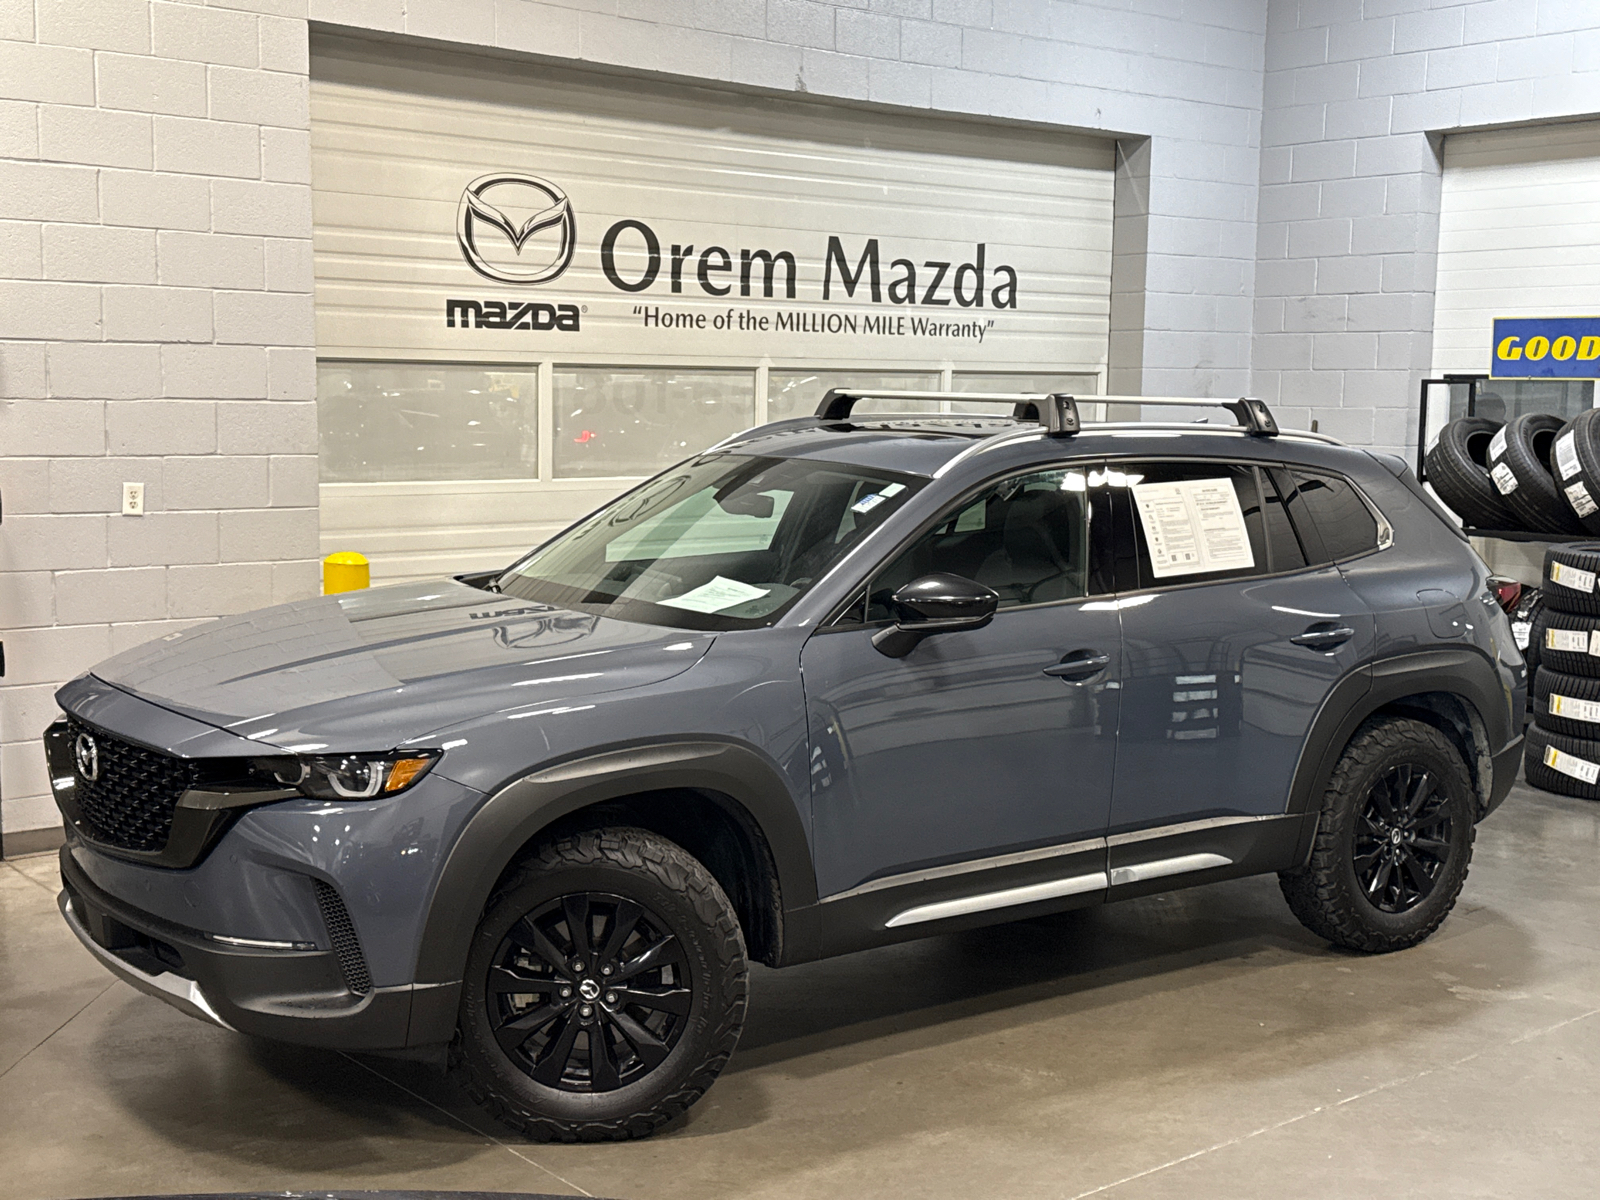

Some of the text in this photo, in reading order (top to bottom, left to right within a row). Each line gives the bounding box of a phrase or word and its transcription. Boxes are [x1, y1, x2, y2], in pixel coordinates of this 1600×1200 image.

[600, 219, 1017, 309] Orem Mazda
[713, 308, 735, 330] of
[738, 310, 769, 331] the
[775, 311, 857, 334] MILLION
[863, 316, 905, 336] MILE
[1497, 335, 1600, 361] GOOD
